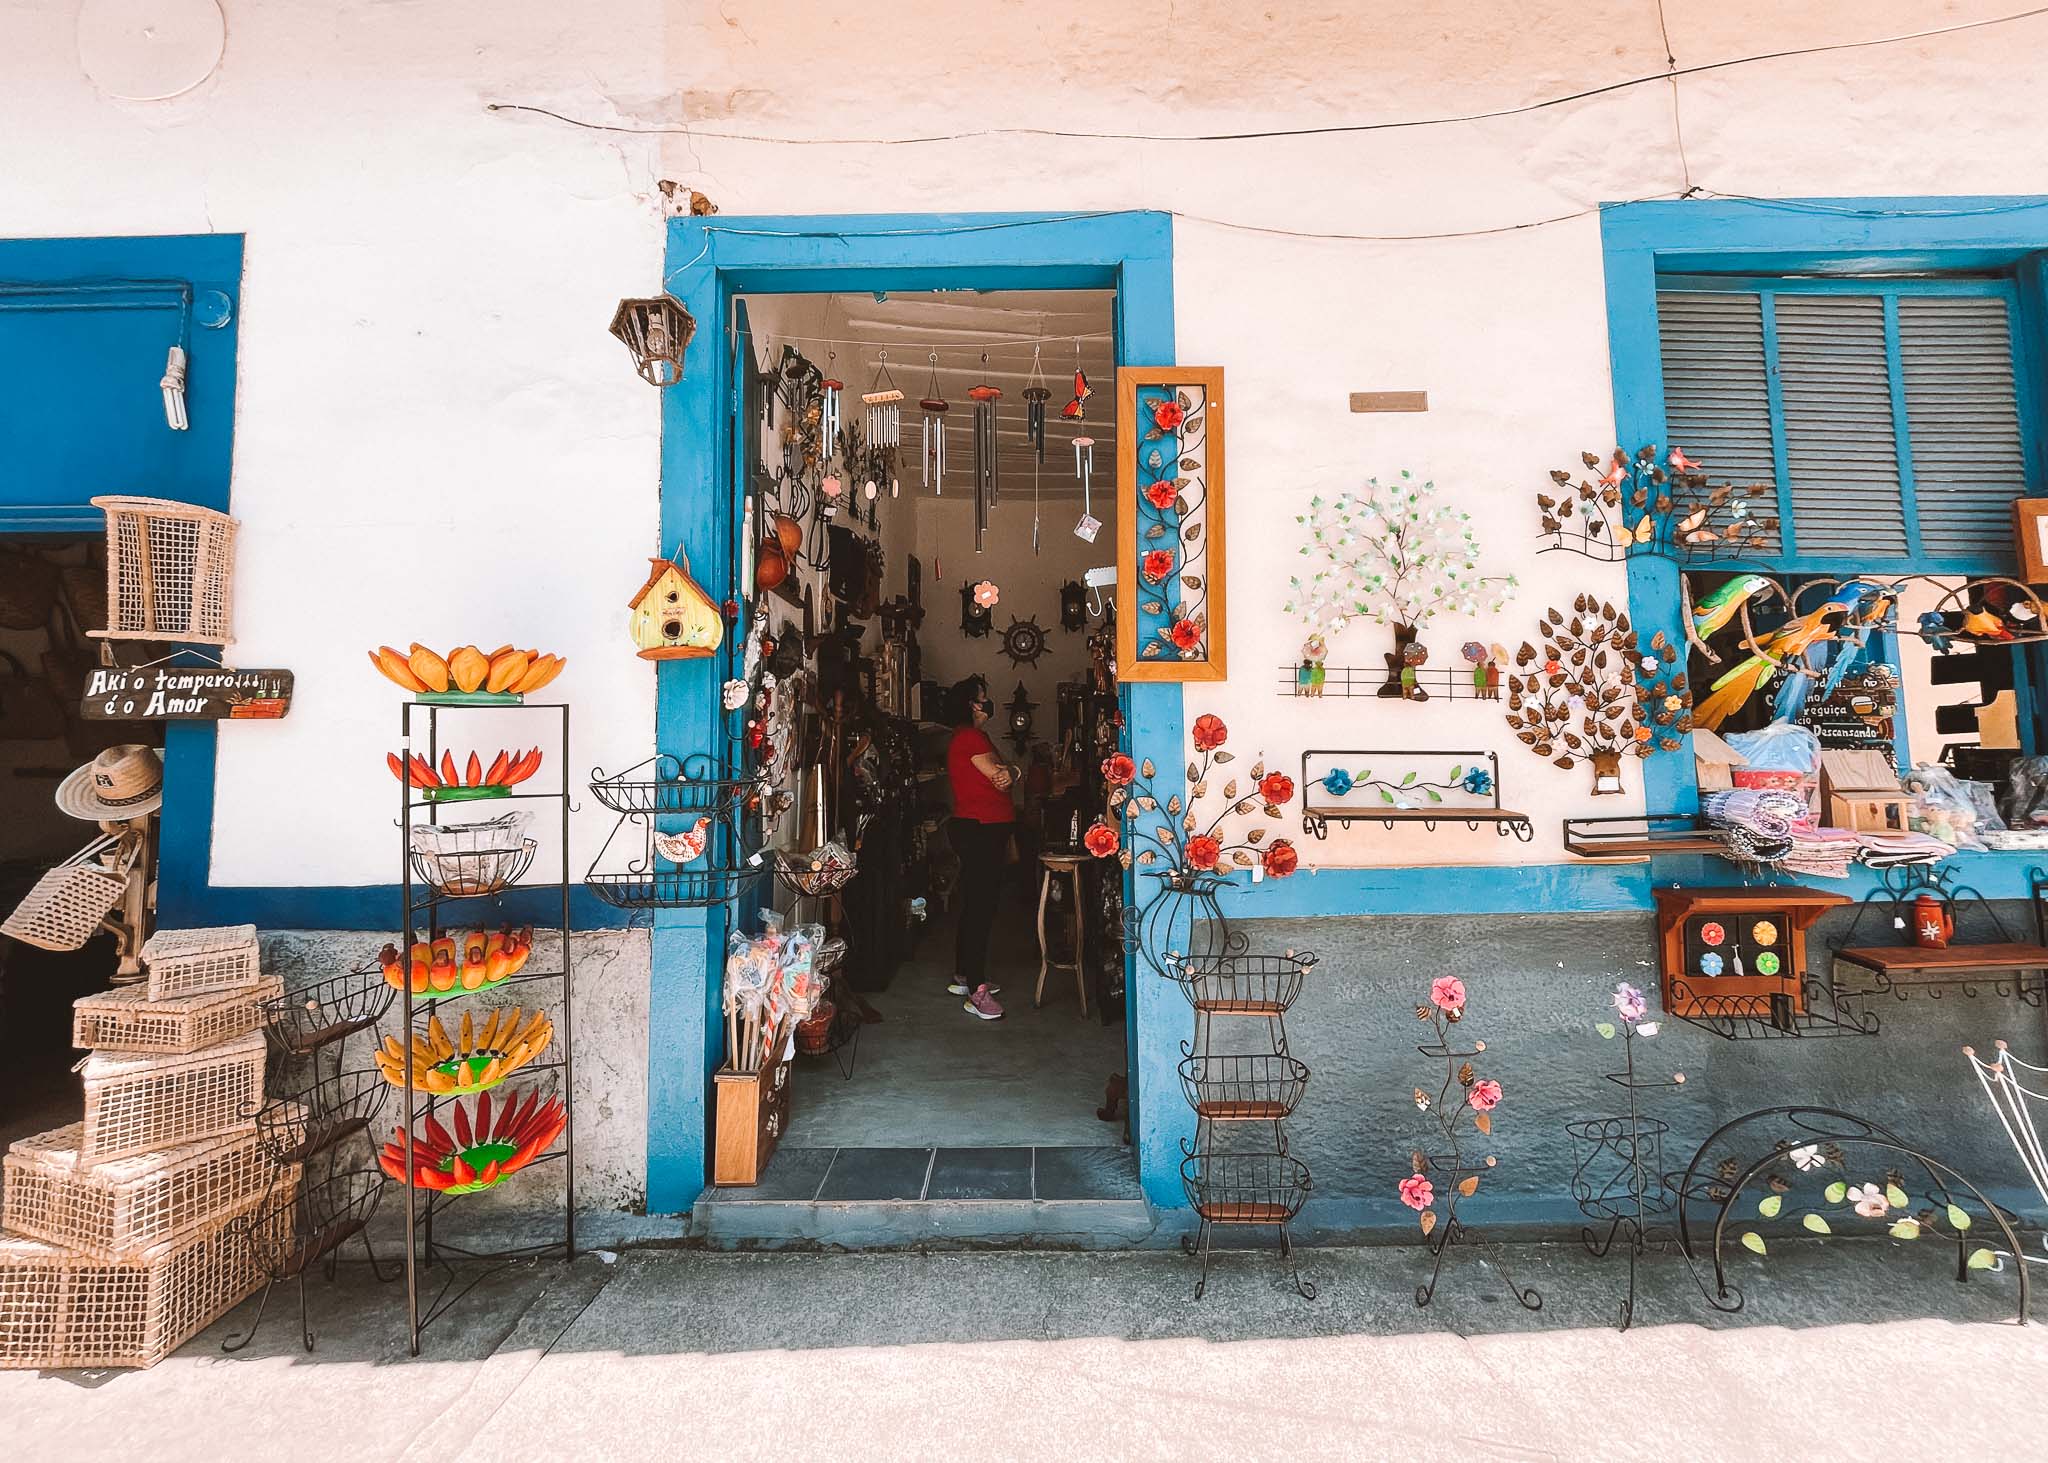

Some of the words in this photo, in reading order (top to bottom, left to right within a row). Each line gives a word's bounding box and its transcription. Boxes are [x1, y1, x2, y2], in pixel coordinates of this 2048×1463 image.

[133, 676, 145, 690] o
[155, 669, 234, 695] tempero
[104, 695, 117, 714] é
[123, 699, 135, 714] o
[143, 690, 208, 716] Amor
[1803, 704, 1848, 716] reguiça
[1813, 724, 1877, 738] Descansando
